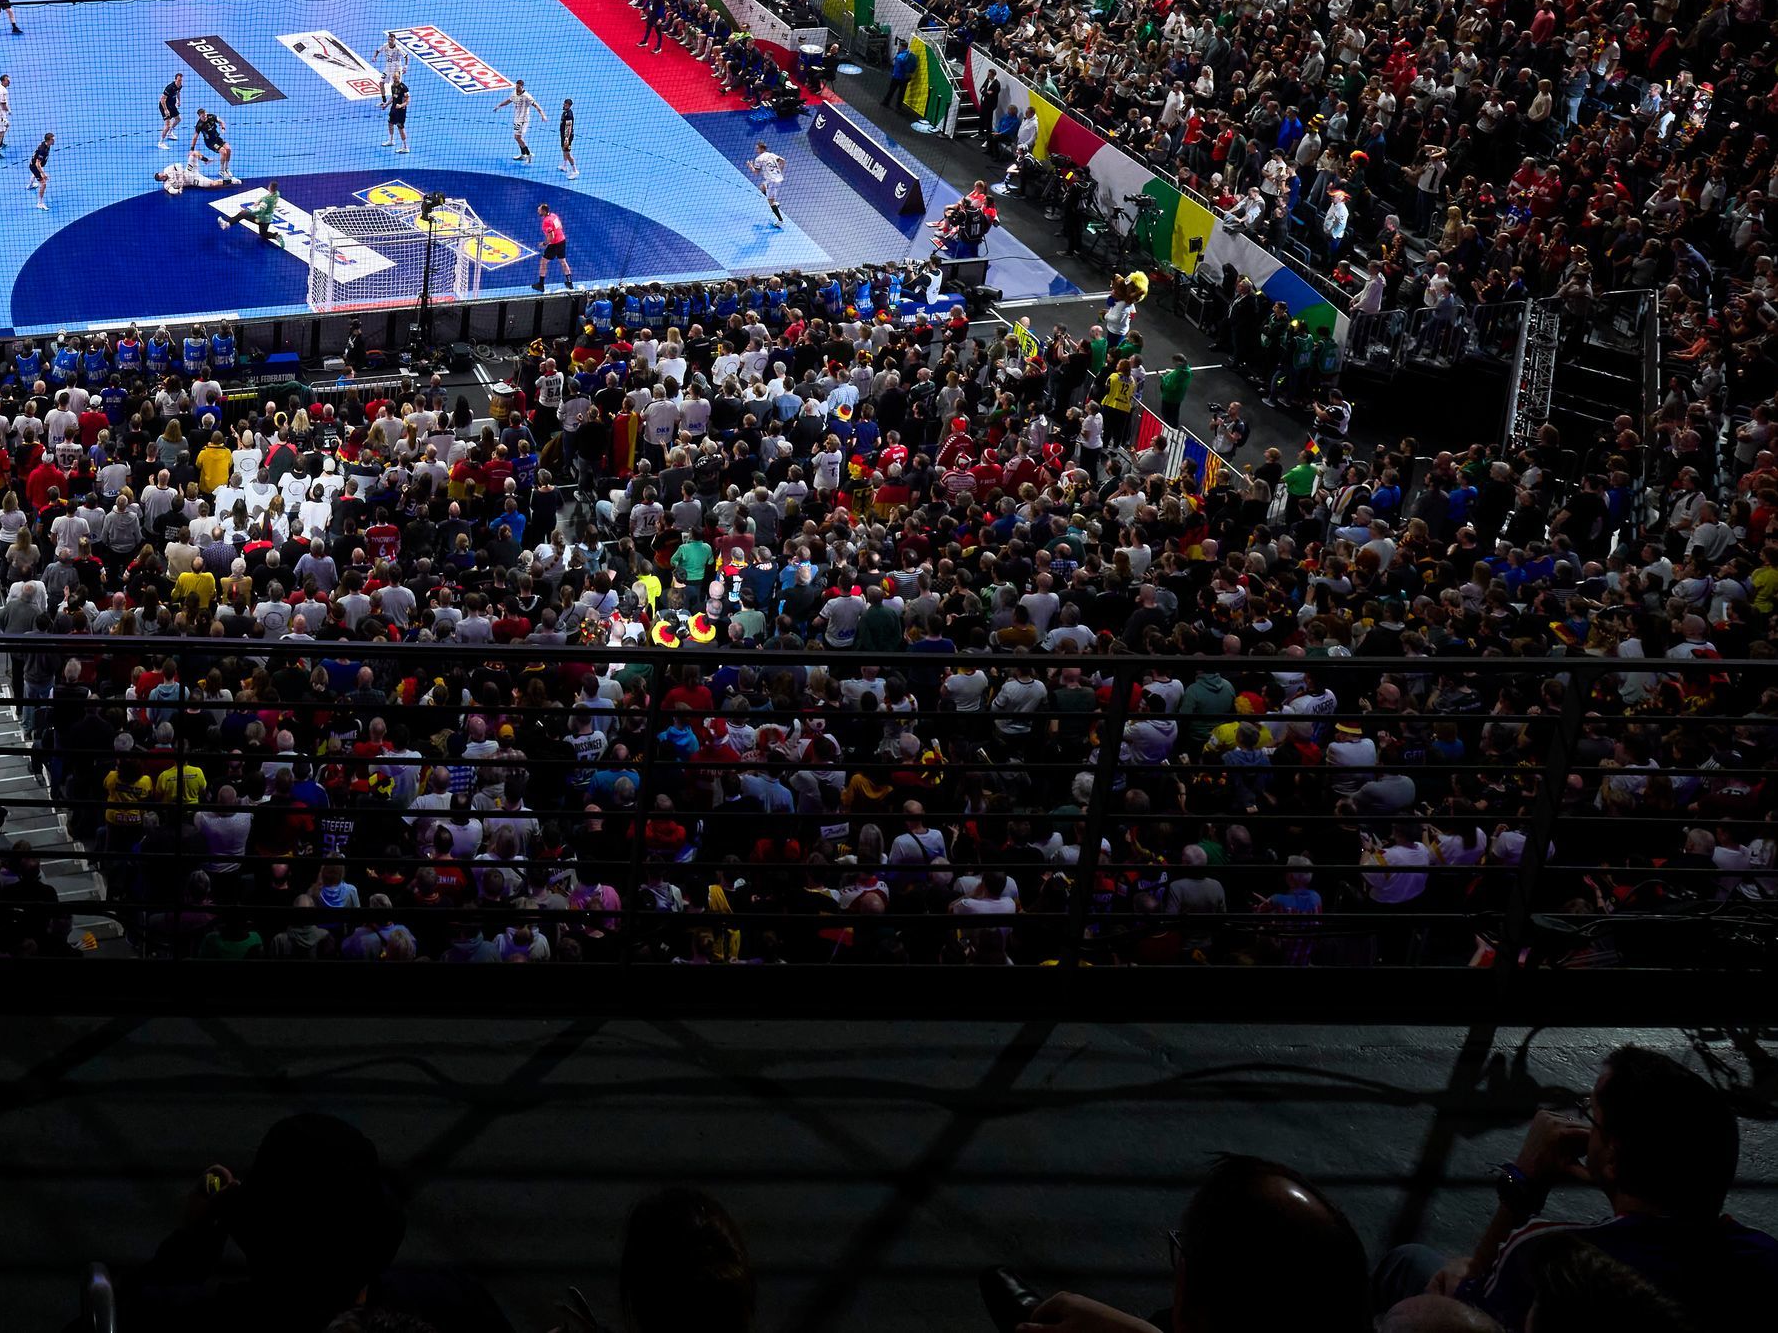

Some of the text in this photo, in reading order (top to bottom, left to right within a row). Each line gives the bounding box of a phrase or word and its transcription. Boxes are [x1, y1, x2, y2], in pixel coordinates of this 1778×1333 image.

[187, 37, 249, 84] freenet
[388, 29, 486, 93] LIQUI
[412, 26, 514, 88] MOLY
[353, 81, 380, 93] DB
[832, 129, 888, 183] EUROHANDBALL.COM
[261, 373, 295, 383] FEDERATION
[547, 387, 561, 398] 54
[1120, 383, 1130, 395] 12
[643, 515, 656, 527] 14
[379, 546, 386, 557] 6
[321, 818, 355, 832] STEFFEN
